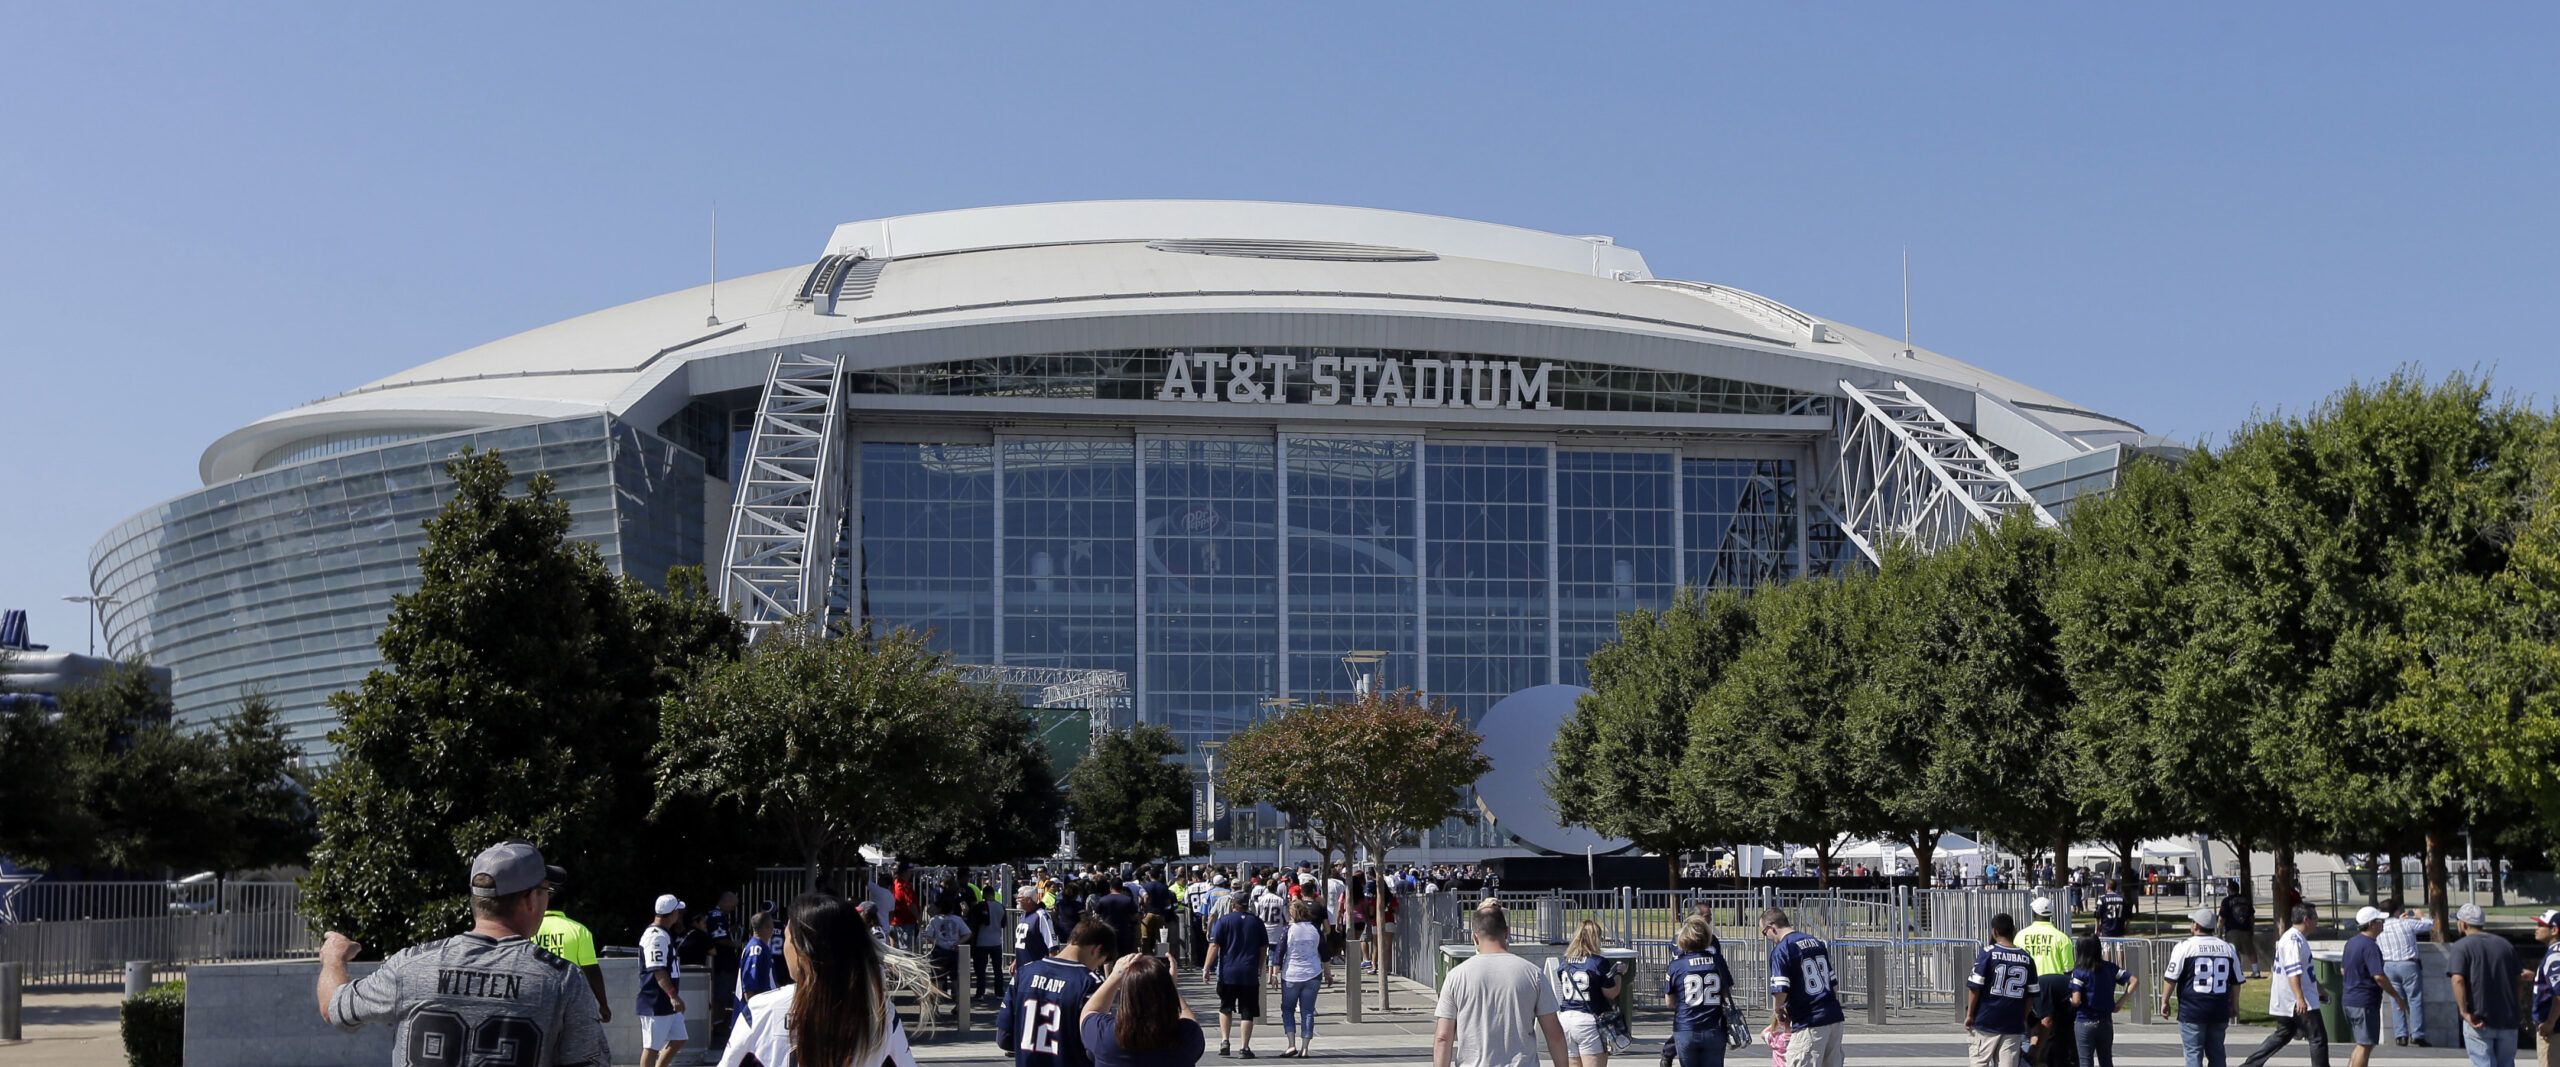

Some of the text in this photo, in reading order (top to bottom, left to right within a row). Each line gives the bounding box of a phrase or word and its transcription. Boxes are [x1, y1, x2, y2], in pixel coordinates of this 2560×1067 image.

[1158, 352, 1553, 411] AT&T STADIUM
[748, 945, 762, 956] 10
[2024, 934, 2054, 945] EVENT
[2024, 945, 2052, 957] STAFF
[650, 950, 664, 962] 12
[1688, 956, 1714, 967] WITTEN
[1991, 952, 2030, 965] STAUBACH
[437, 969, 523, 1000] WITTEN
[1030, 974, 1066, 993] BRADY
[1561, 970, 1591, 1001] 82
[1989, 963, 2029, 999] 12
[2192, 957, 2230, 994] 88
[1683, 972, 1721, 1007] 82
[1020, 999, 1062, 1056] 12
